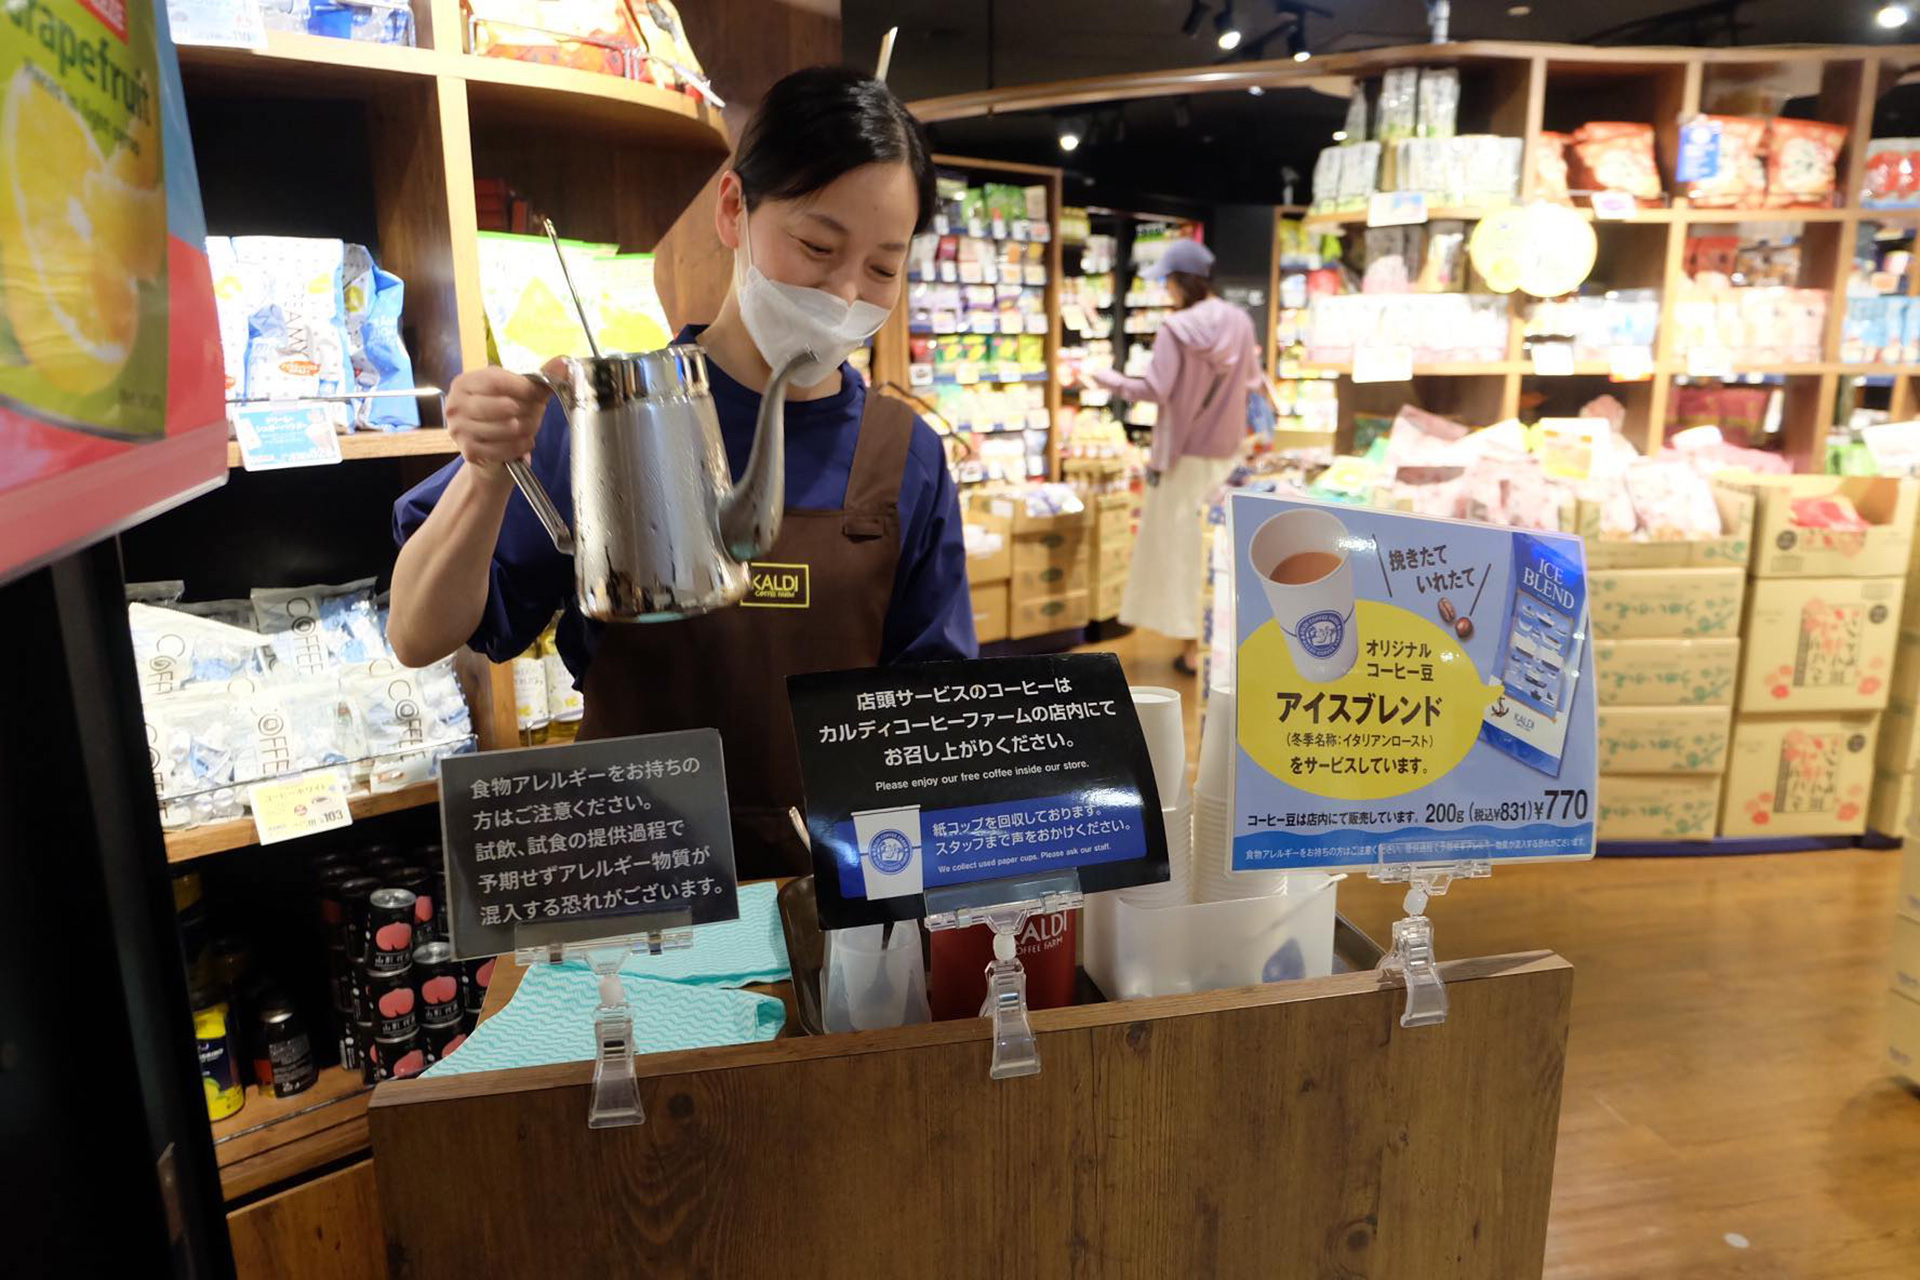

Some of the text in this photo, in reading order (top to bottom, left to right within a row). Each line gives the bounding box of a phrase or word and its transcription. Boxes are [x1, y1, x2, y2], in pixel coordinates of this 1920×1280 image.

[8, 0, 150, 126] rapefruit
[1389, 544, 1448, 572] 挽きたて
[1539, 558, 1565, 585] ICE
[1416, 567, 1475, 594] いれたて
[1522, 566, 1576, 610] BLEND
[1366, 639, 1431, 659] オリジナル
[1367, 662, 1434, 681] コーヒー豆
[857, 676, 1073, 711] 店頭サービスのコーヒーは
[1276, 692, 1443, 727] アイスブレンド
[818, 700, 1117, 744] カルディコーヒーファームの店内にて
[884, 732, 1075, 767] お召し上がりください。
[1290, 757, 1428, 775] をサービスしています。
[470, 757, 700, 800] 食物アレルギーをお持ちの
[875, 760, 1090, 791] Please enjoy our free coffee inside our store.
[473, 795, 653, 831] 方はご注意ください。
[932, 803, 1102, 837] 紙コップを回収しております。
[1247, 811, 1418, 827] コーヒー豆は店内にて販売しています。
[1425, 803, 1464, 823] 200g
[475, 820, 685, 862] 試飲、試食の提供過程で
[935, 819, 1131, 856] スタッフまで声をおかけください。
[478, 847, 710, 894] 予期せずアレルギー物質が
[938, 865, 951, 873] We
[952, 861, 977, 872] collect
[978, 858, 996, 868] used
[997, 857, 1018, 866] paper
[1040, 850, 1064, 859] Please
[1066, 847, 1079, 856] ask
[1080, 846, 1093, 854] our
[480, 877, 723, 926] 混入する恐れがございます。
[1016, 909, 1067, 945] ALDI
[1015, 936, 1064, 956] OFFEE FARM
